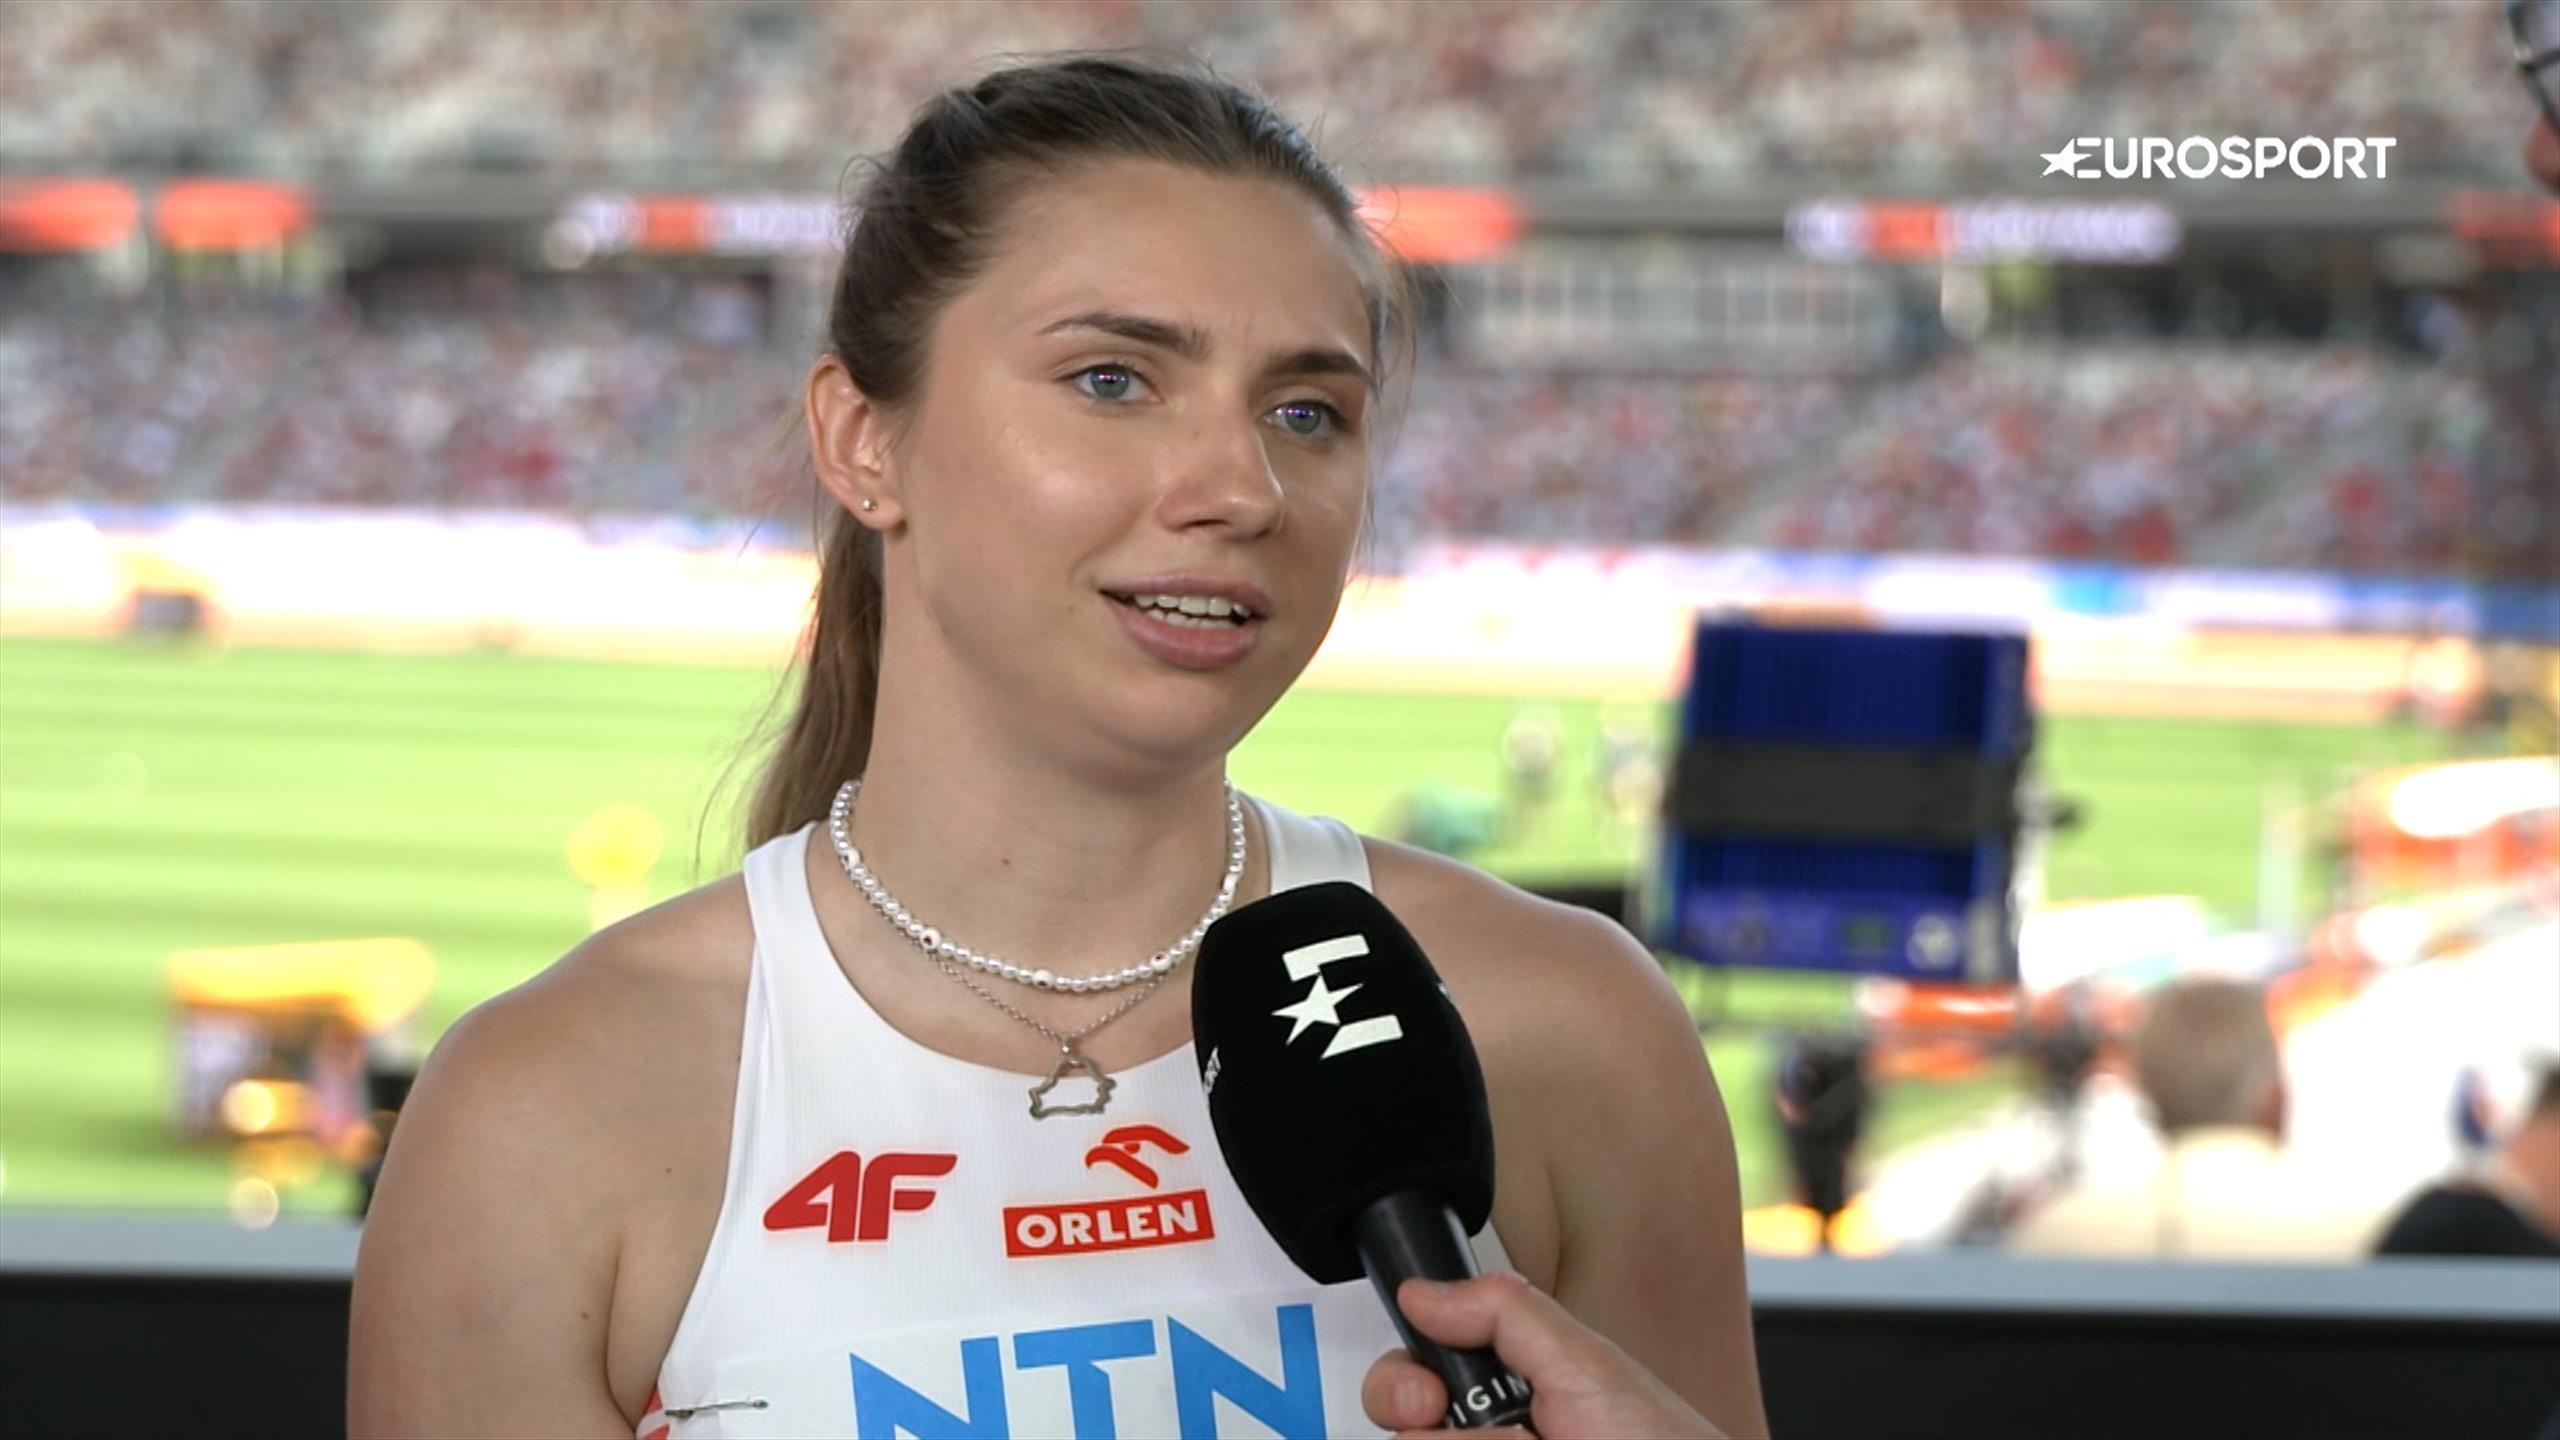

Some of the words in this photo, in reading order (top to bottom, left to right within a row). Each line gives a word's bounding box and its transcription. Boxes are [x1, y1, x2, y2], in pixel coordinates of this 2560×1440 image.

[763, 1150, 958, 1243] 4F
[1015, 1200, 1198, 1249] ORLEN
[849, 1303, 1327, 1440] NTN
